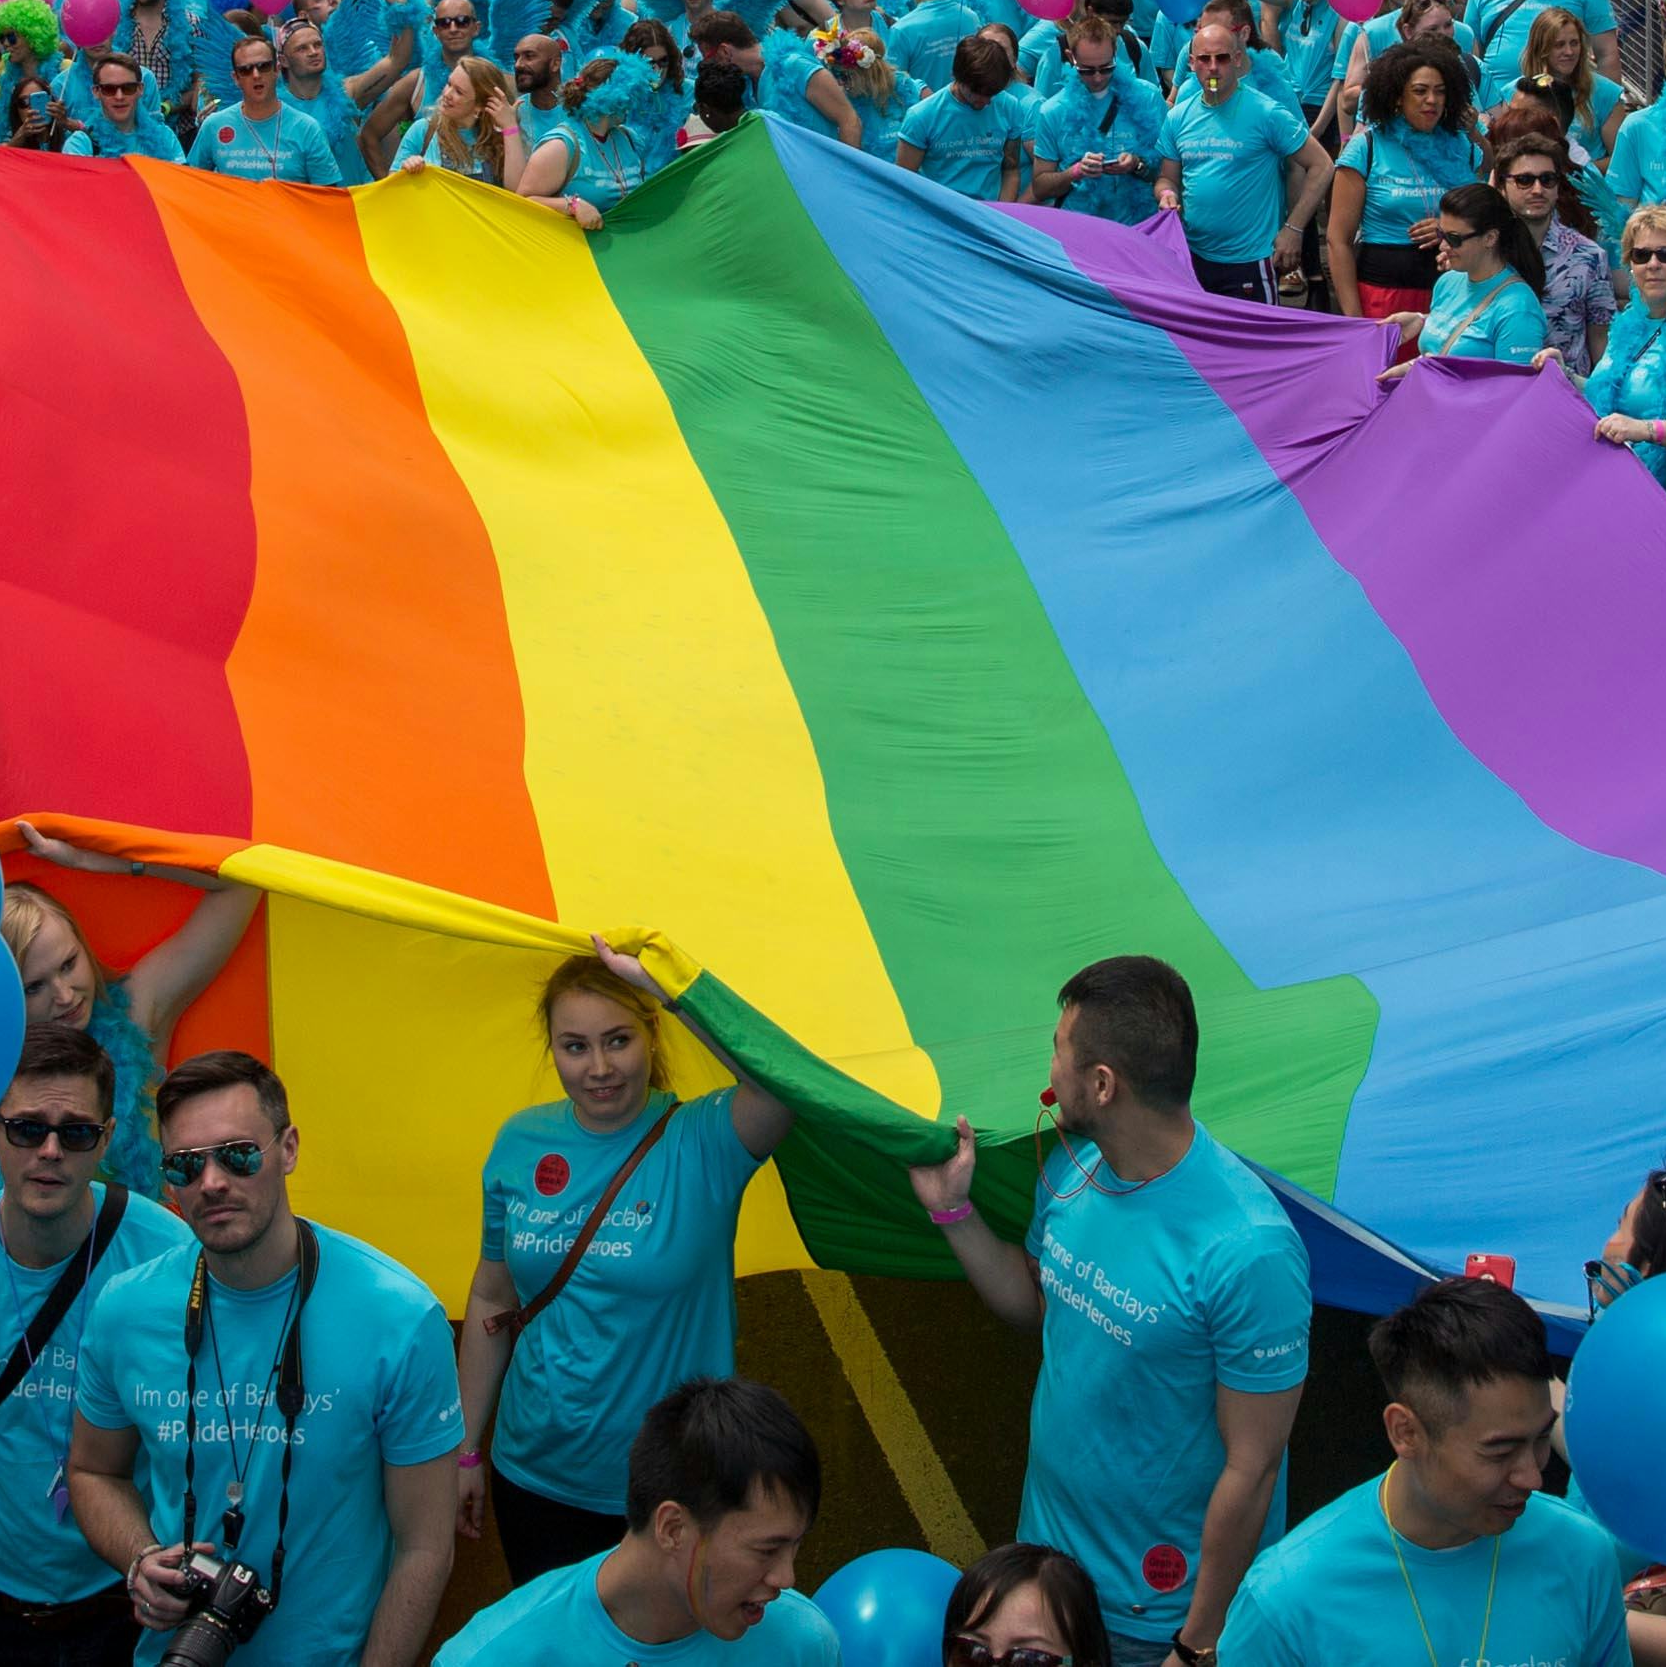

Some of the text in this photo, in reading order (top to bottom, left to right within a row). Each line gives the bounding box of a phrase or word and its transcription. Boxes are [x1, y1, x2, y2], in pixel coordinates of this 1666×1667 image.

[1199, 136, 1208, 148] of
[506, 1194, 586, 1226] I'm one of
[513, 1231, 633, 1258] #Prideeroes
[191, 1256, 204, 1309] Nikon
[1050, 1240, 1074, 1270] one
[1074, 1256, 1095, 1281] of
[1093, 1266, 1166, 1324] Barclays'
[1040, 1265, 1133, 1347] #PrideHeroes
[135, 1384, 160, 1406] I'm
[216, 1383, 238, 1407] of
[157, 1419, 306, 1446] #PideHeroes
